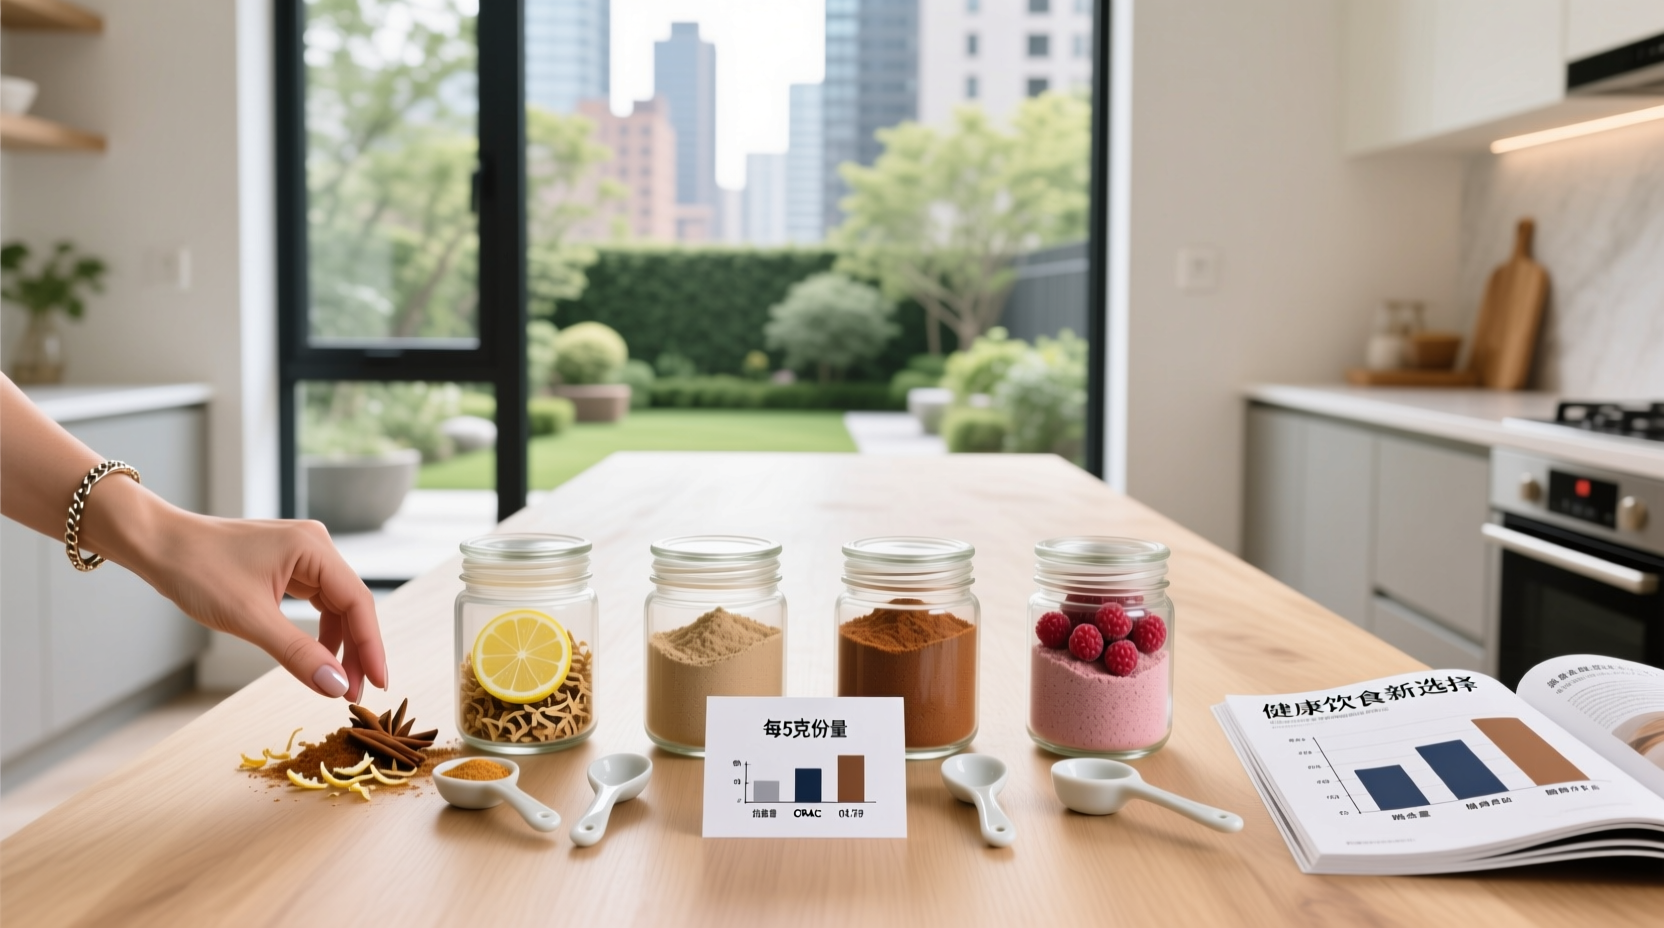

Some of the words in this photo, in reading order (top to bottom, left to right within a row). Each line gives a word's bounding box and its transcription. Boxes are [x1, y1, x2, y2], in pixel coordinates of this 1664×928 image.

[1263, 676, 1478, 719] 健康饮食新选择
[763, 718, 847, 738] 每5克份量
